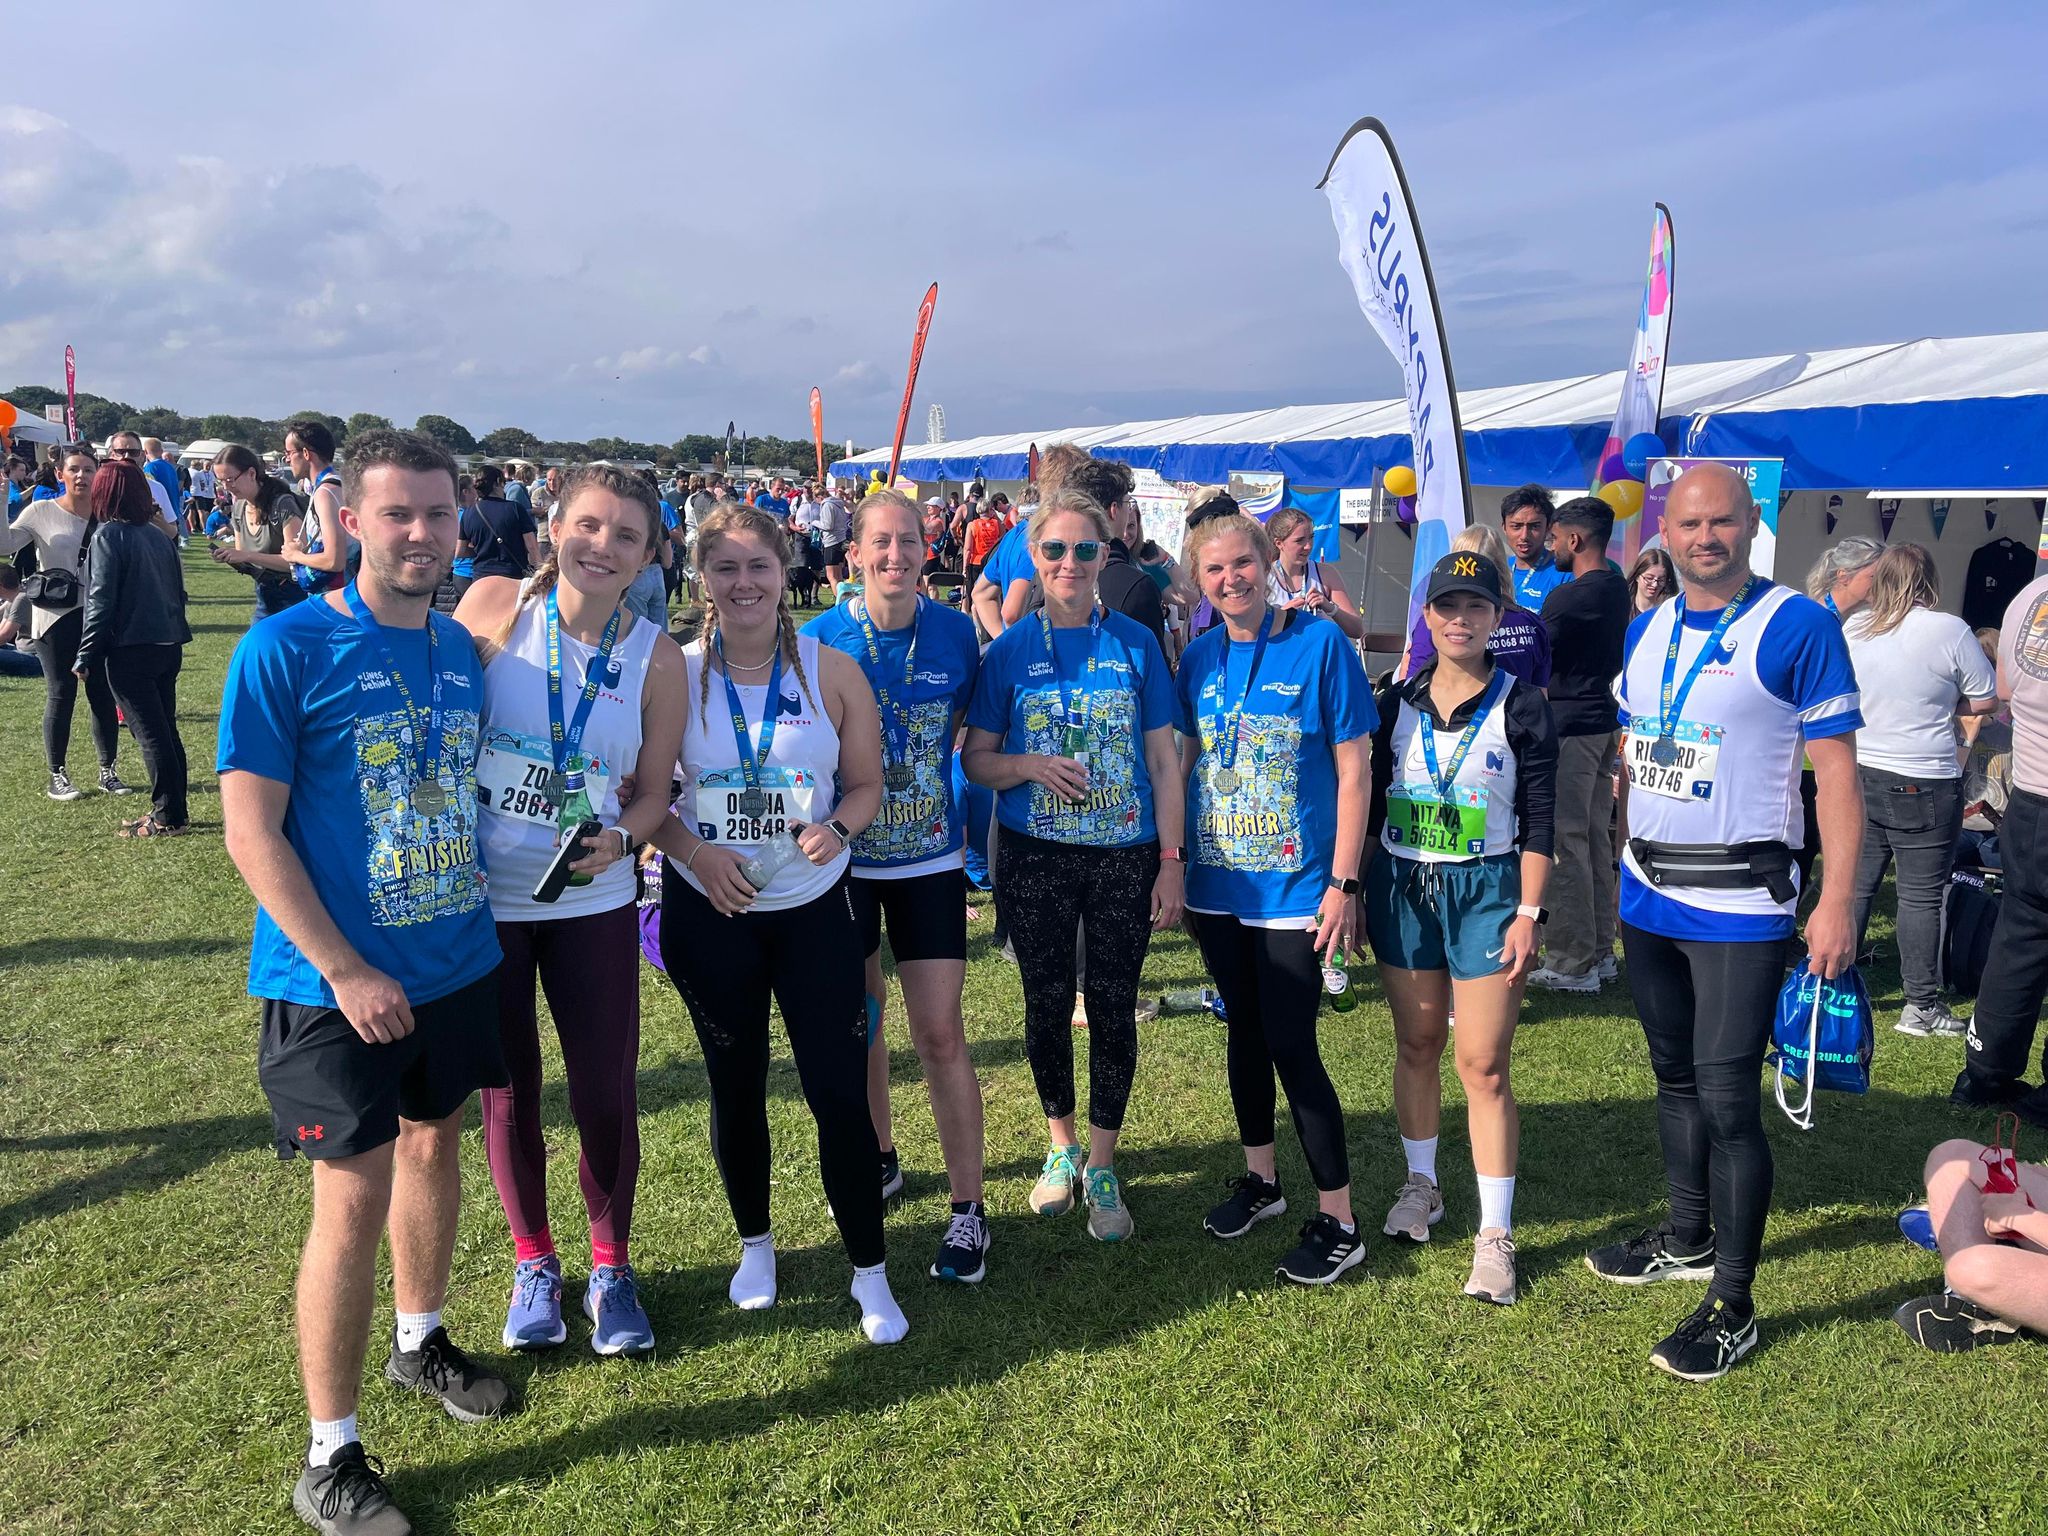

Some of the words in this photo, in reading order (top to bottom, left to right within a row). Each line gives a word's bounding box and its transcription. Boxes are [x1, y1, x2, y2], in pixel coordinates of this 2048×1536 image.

[1346, 500, 1356, 508] THE
[1501, 637, 1517, 648] 068
[2017, 628, 2028, 649] WEST
[1028, 667, 1053, 677] behind
[1032, 661, 1050, 671] Lives
[1087, 656, 1096, 673] 2022
[1700, 669, 1735, 677] OUTH
[360, 677, 392, 691] behind
[363, 671, 384, 681] Lives
[585, 681, 598, 701] 2022
[880, 688, 890, 706] 2022
[733, 714, 746, 733] 2022
[900, 709, 908, 726] 2022
[552, 721, 563, 742] 2022
[484, 749, 494, 757] 34
[1635, 740, 1696, 769] RIRD
[426, 758, 436, 779] 2022
[522, 763, 554, 791] ZO
[1481, 770, 1505, 778] YOUTH
[1640, 765, 1683, 793] 28746
[542, 785, 565, 797] FINIS
[500, 787, 559, 823] 2964
[727, 793, 785, 815] OIA
[727, 818, 785, 841] 29648
[1205, 812, 1281, 837] FINISHER
[1410, 825, 1458, 851] 56514
[384, 882, 407, 893] FINISH
[1952, 872, 1985, 888] PAPYRUS
[1836, 994, 1858, 1006] ru
